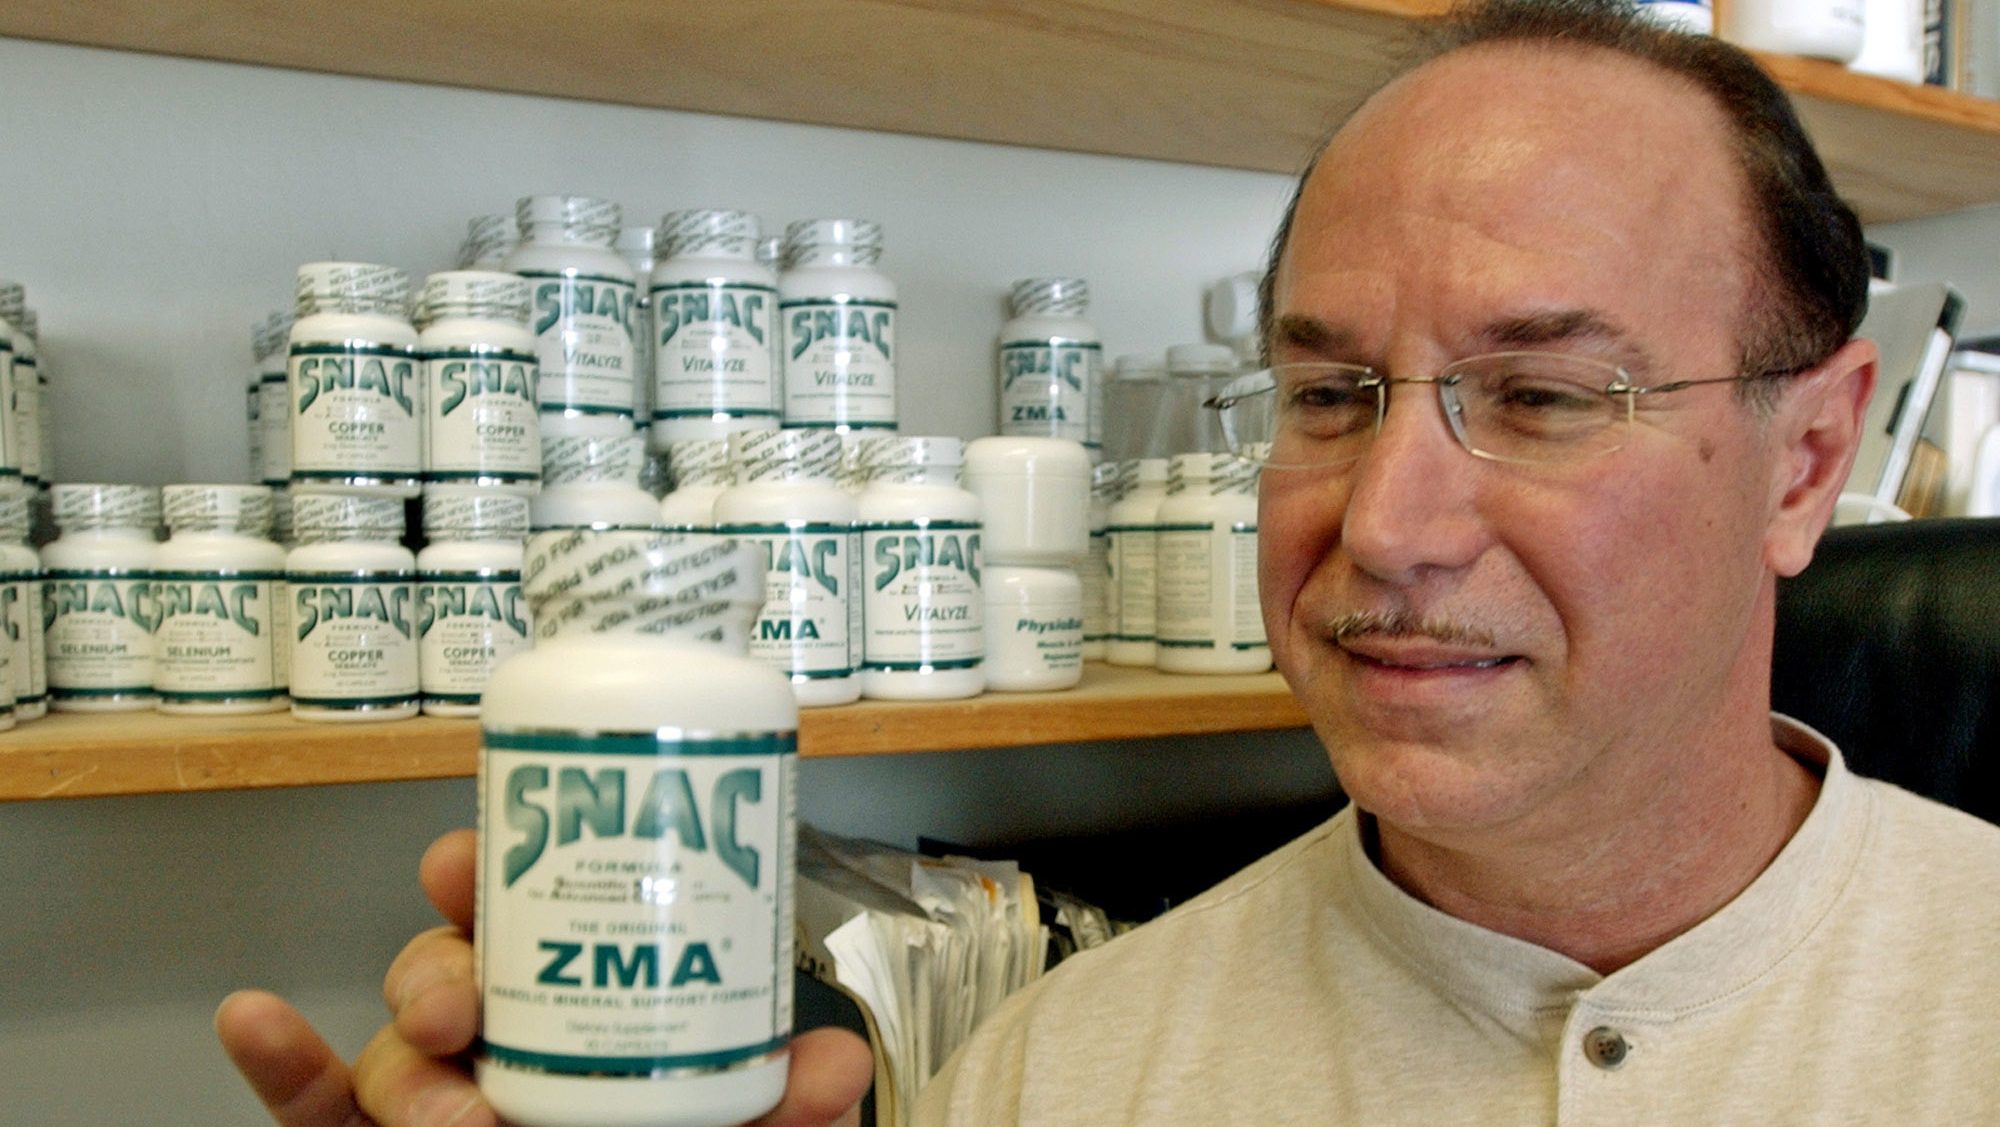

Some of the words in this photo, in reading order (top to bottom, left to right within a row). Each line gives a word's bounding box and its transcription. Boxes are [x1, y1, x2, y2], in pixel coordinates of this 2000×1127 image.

[660, 293, 764, 347] SNAC
[791, 310, 889, 362] SNAC
[1004, 350, 1082, 391] SNAC
[299, 358, 413, 417] SNAC
[1011, 405, 1066, 421] ZMA
[328, 421, 385, 434] COPPER
[476, 424, 525, 437] COPPER
[874, 534, 981, 592] SNAC
[296, 586, 411, 643] SNAC
[419, 586, 528, 640] SNAC
[752, 619, 820, 641] MA
[60, 643, 127, 655] SELENIUM
[166, 646, 231, 658] SELENIUM
[327, 650, 384, 662] COPPER
[442, 646, 496, 659] COPPER
[503, 765, 763, 891] SNAC
[570, 920, 599, 934] THE
[537, 938, 723, 988] ZMA
[552, 993, 624, 1009] MINERAL
